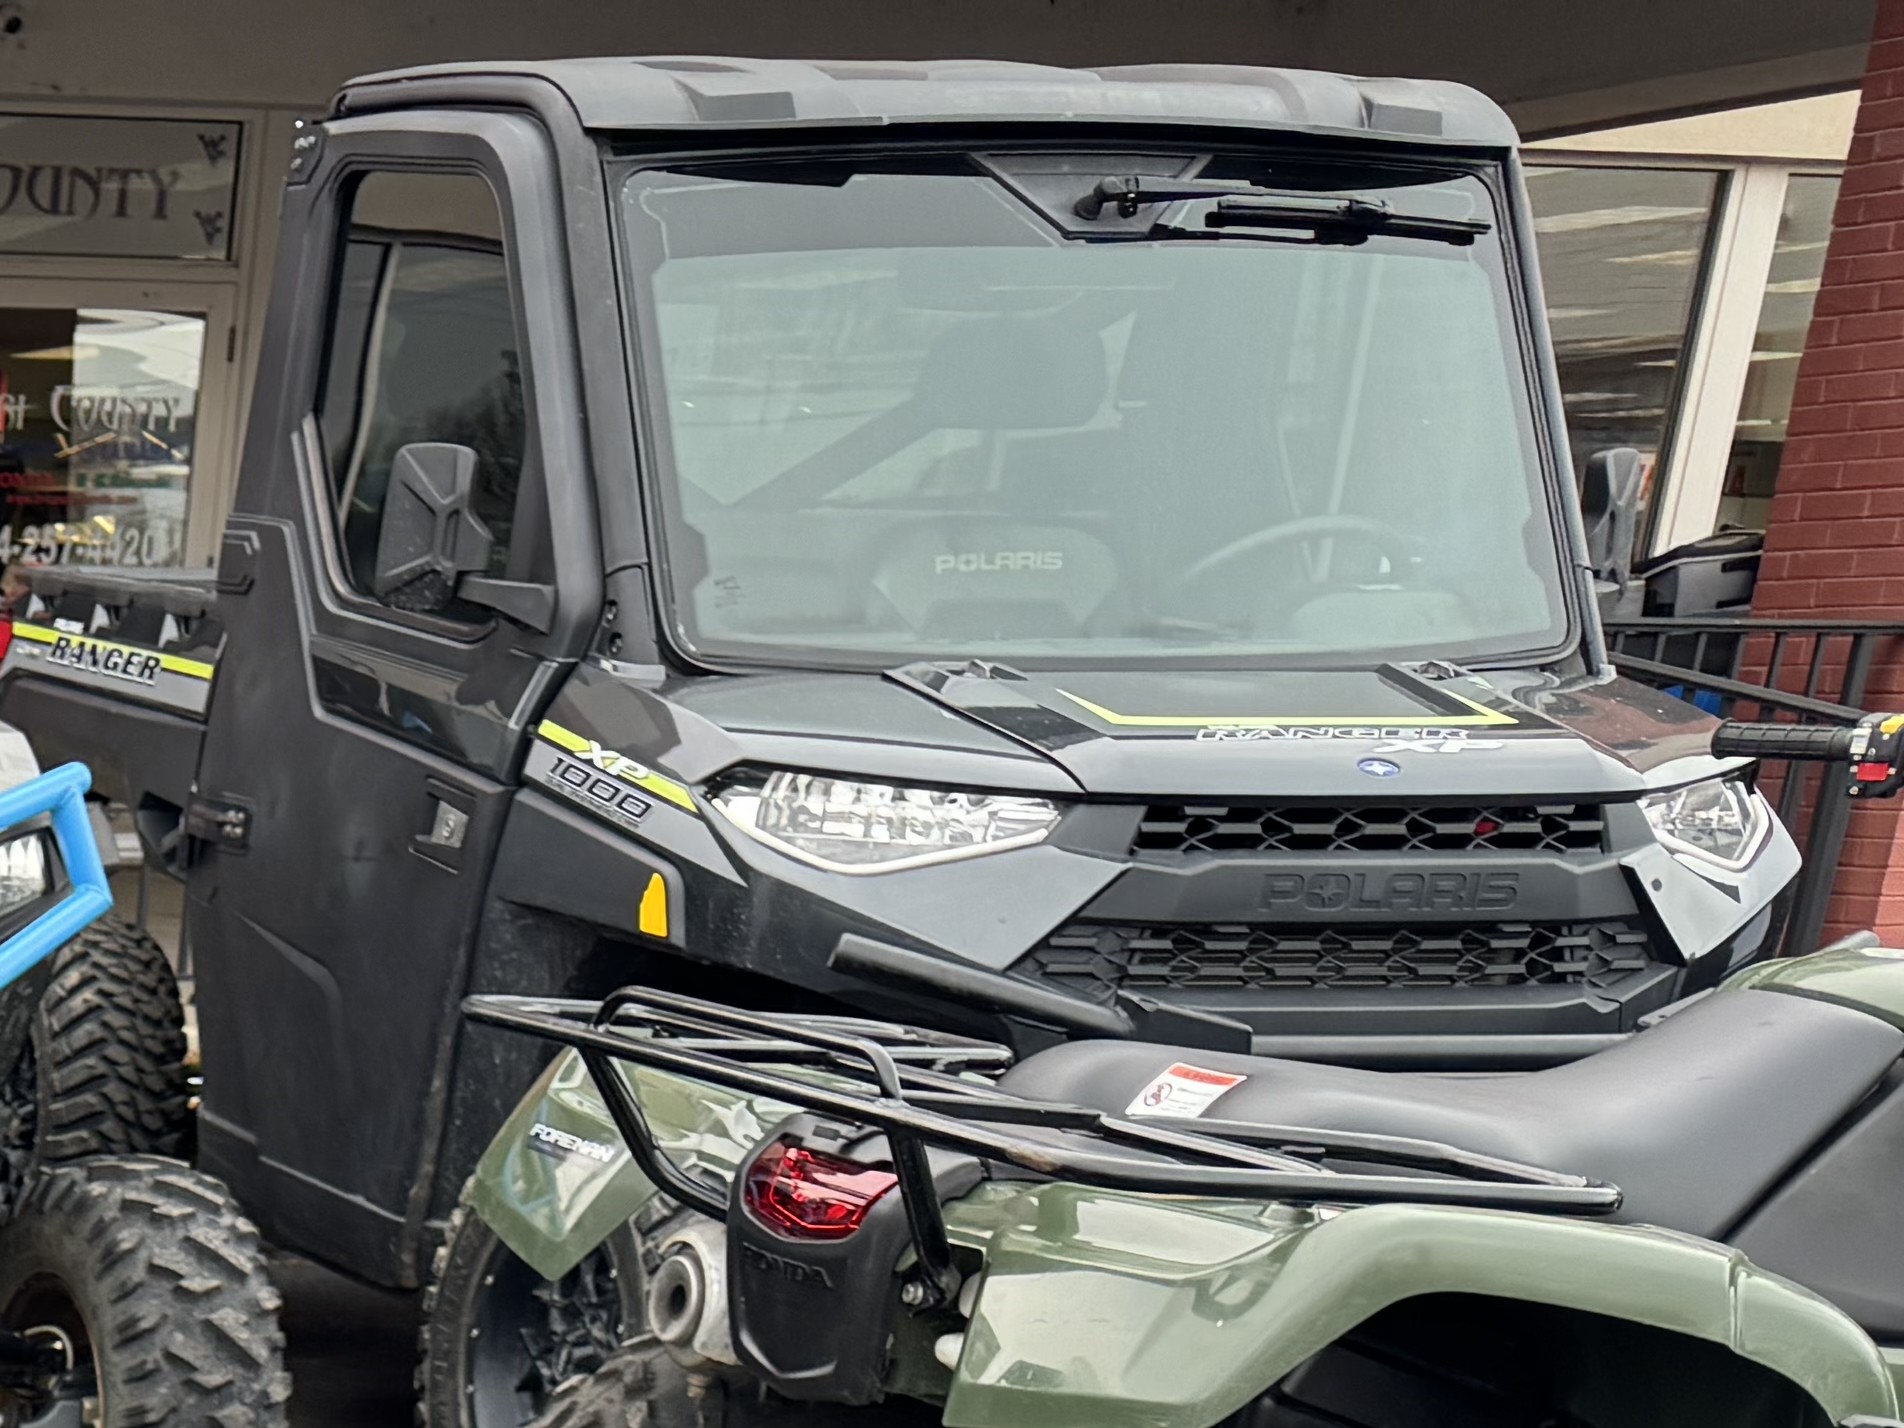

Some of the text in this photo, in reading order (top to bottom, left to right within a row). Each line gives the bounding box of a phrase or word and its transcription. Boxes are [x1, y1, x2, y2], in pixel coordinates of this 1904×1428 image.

[934, 551, 1064, 575] POLARIS
[49, 636, 161, 684] RANGER
[574, 740, 650, 780] XP
[1374, 739, 1504, 754] XP
[549, 756, 652, 820] 1000
[1257, 872, 1520, 913] POLARIS
[529, 1123, 615, 1163] FOREMAN
